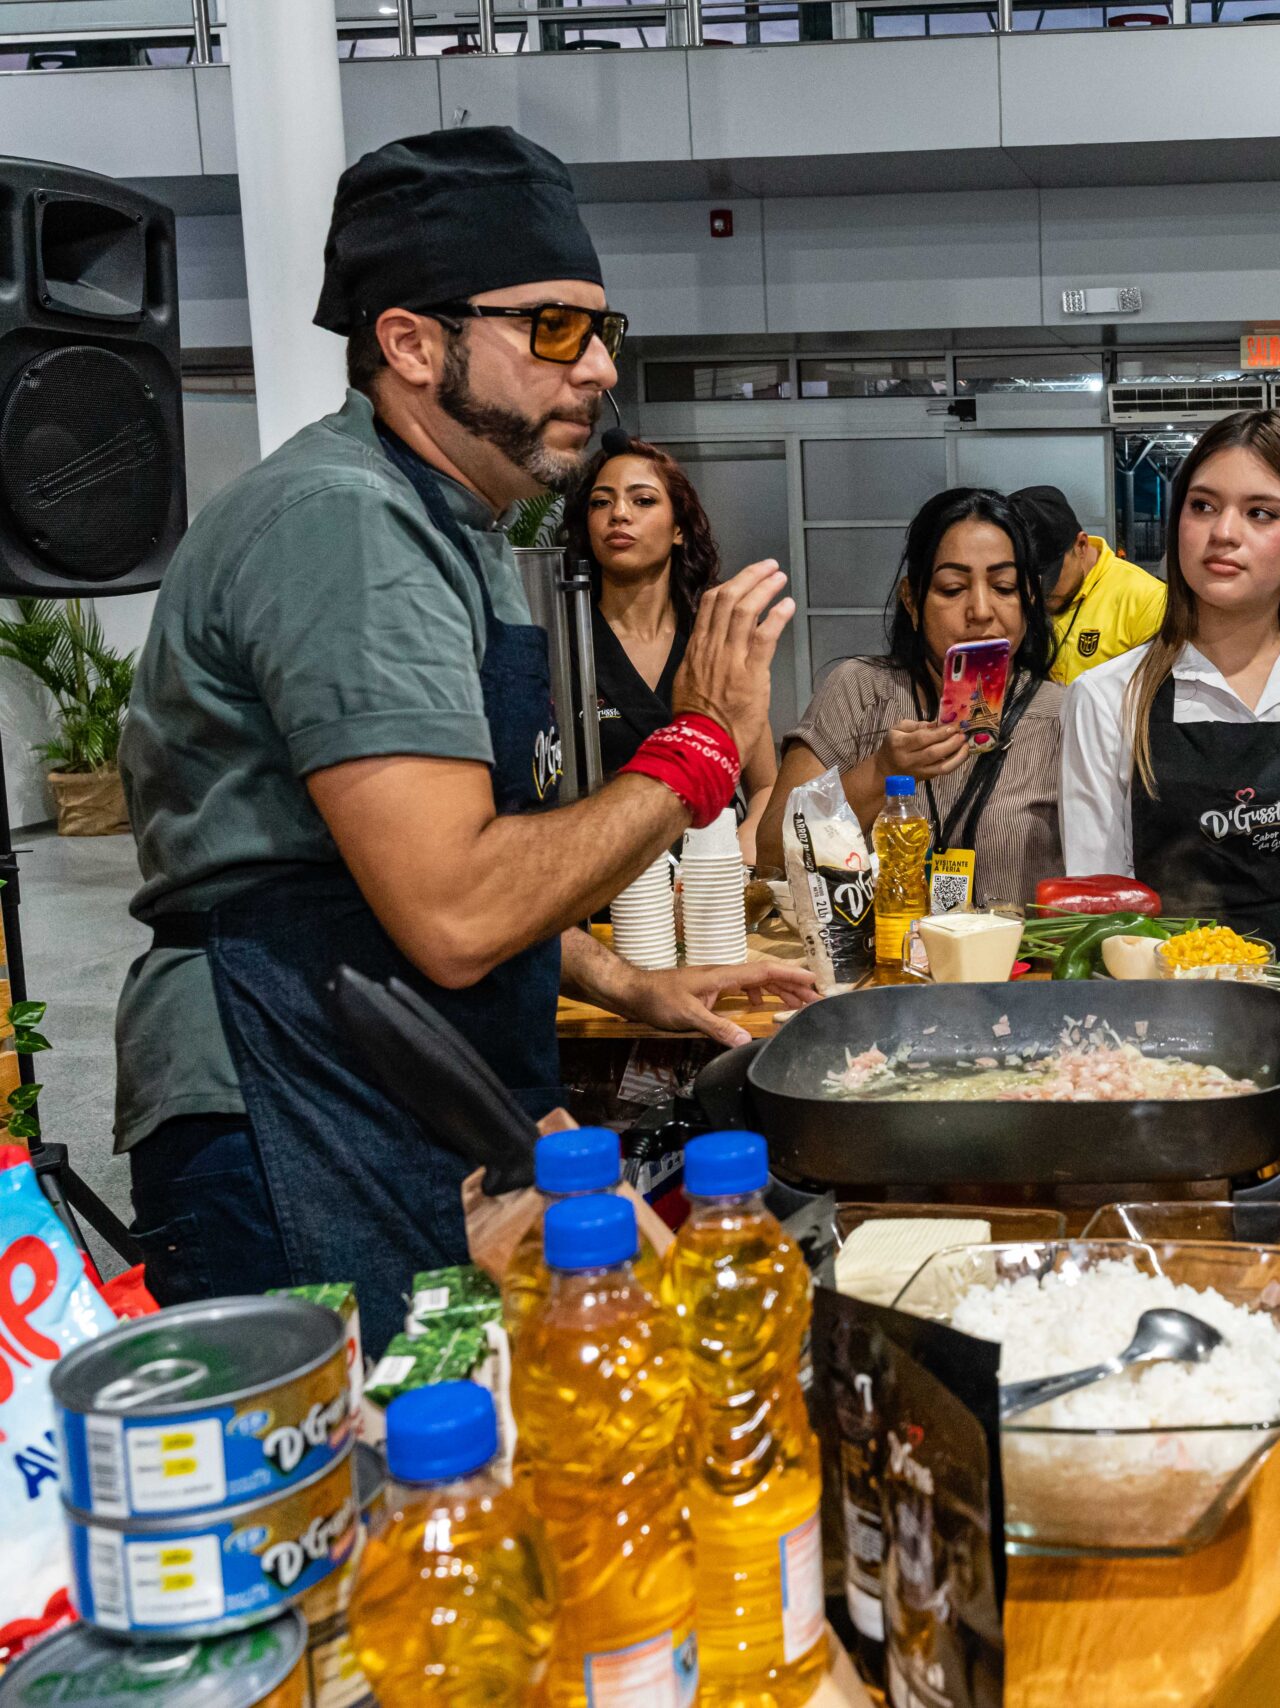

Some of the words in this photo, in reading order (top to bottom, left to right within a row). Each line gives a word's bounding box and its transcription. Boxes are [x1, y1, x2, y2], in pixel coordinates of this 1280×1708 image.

[794, 817, 809, 845] ARROZ
[1252, 831, 1279, 846] Sabor
[934, 860, 969, 868] VISITANTE
